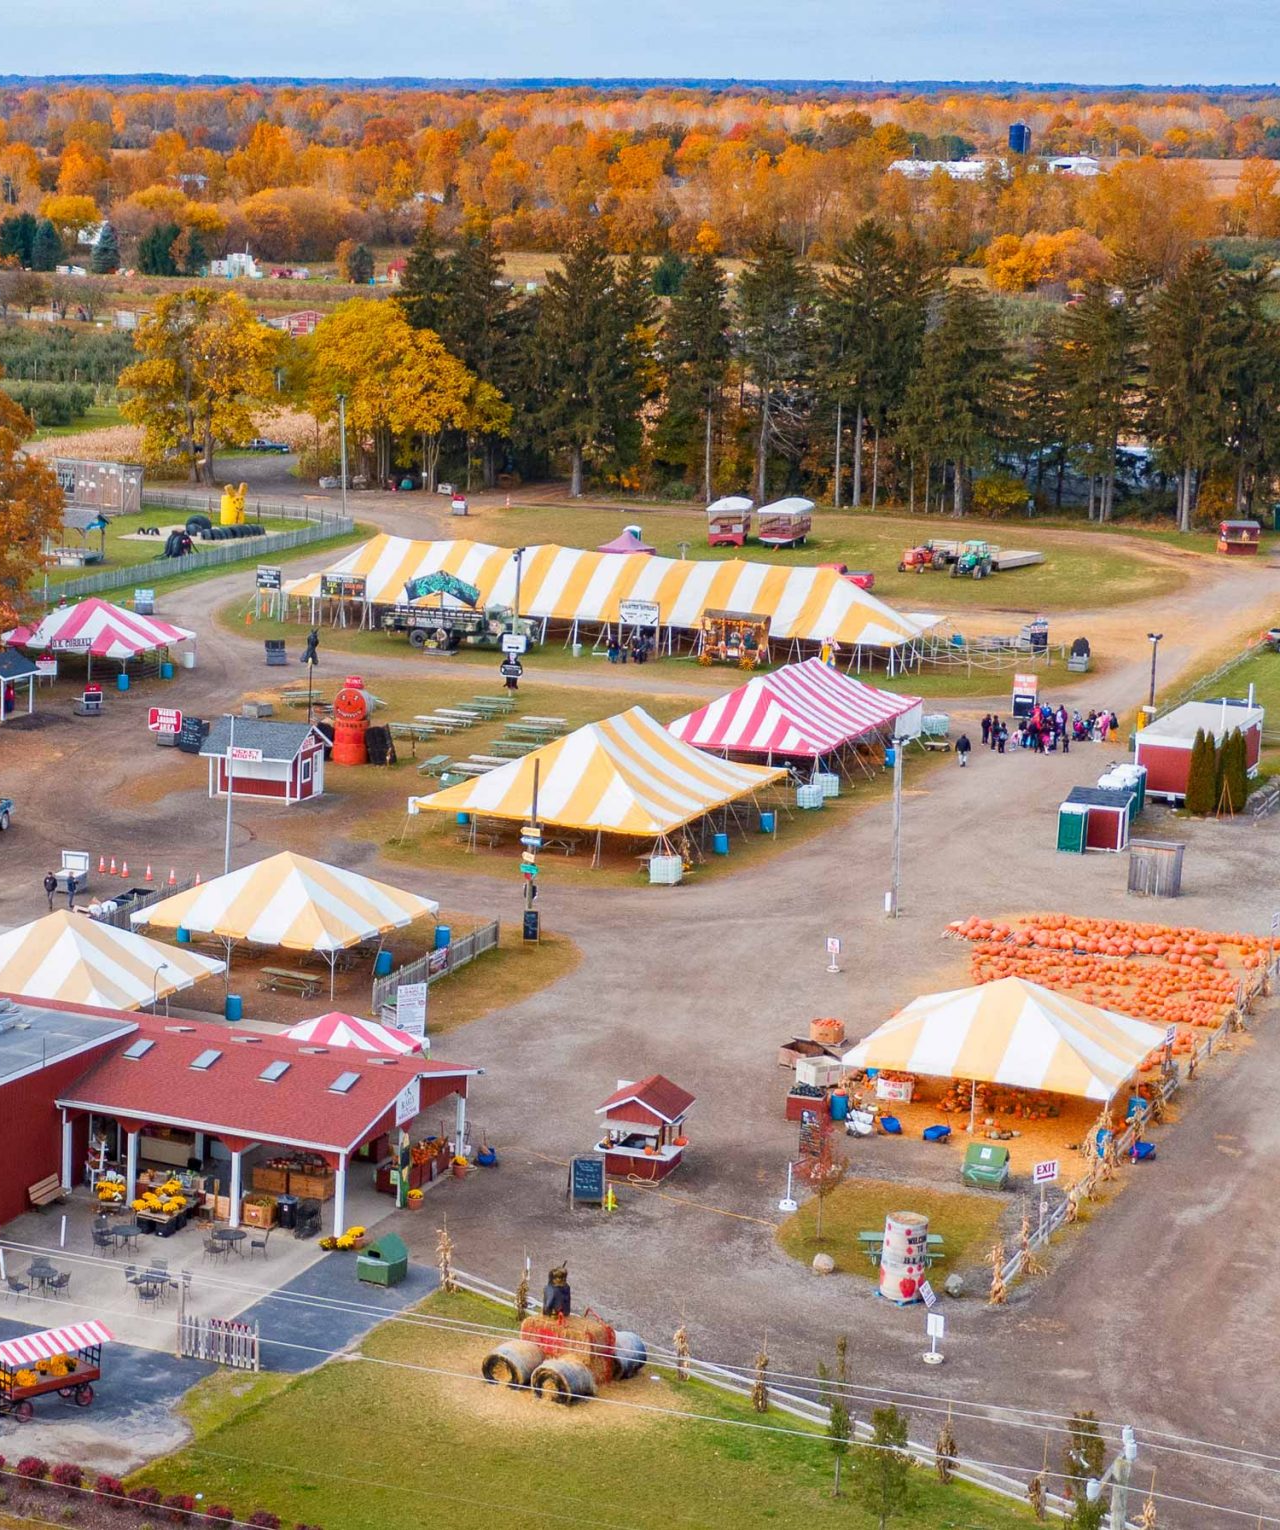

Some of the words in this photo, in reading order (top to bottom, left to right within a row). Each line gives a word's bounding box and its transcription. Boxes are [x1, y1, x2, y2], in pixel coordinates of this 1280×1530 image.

[157, 716, 177, 724] LOADING
[159, 724, 175, 733] AREA
[1036, 1161, 1056, 1175] EXIT
